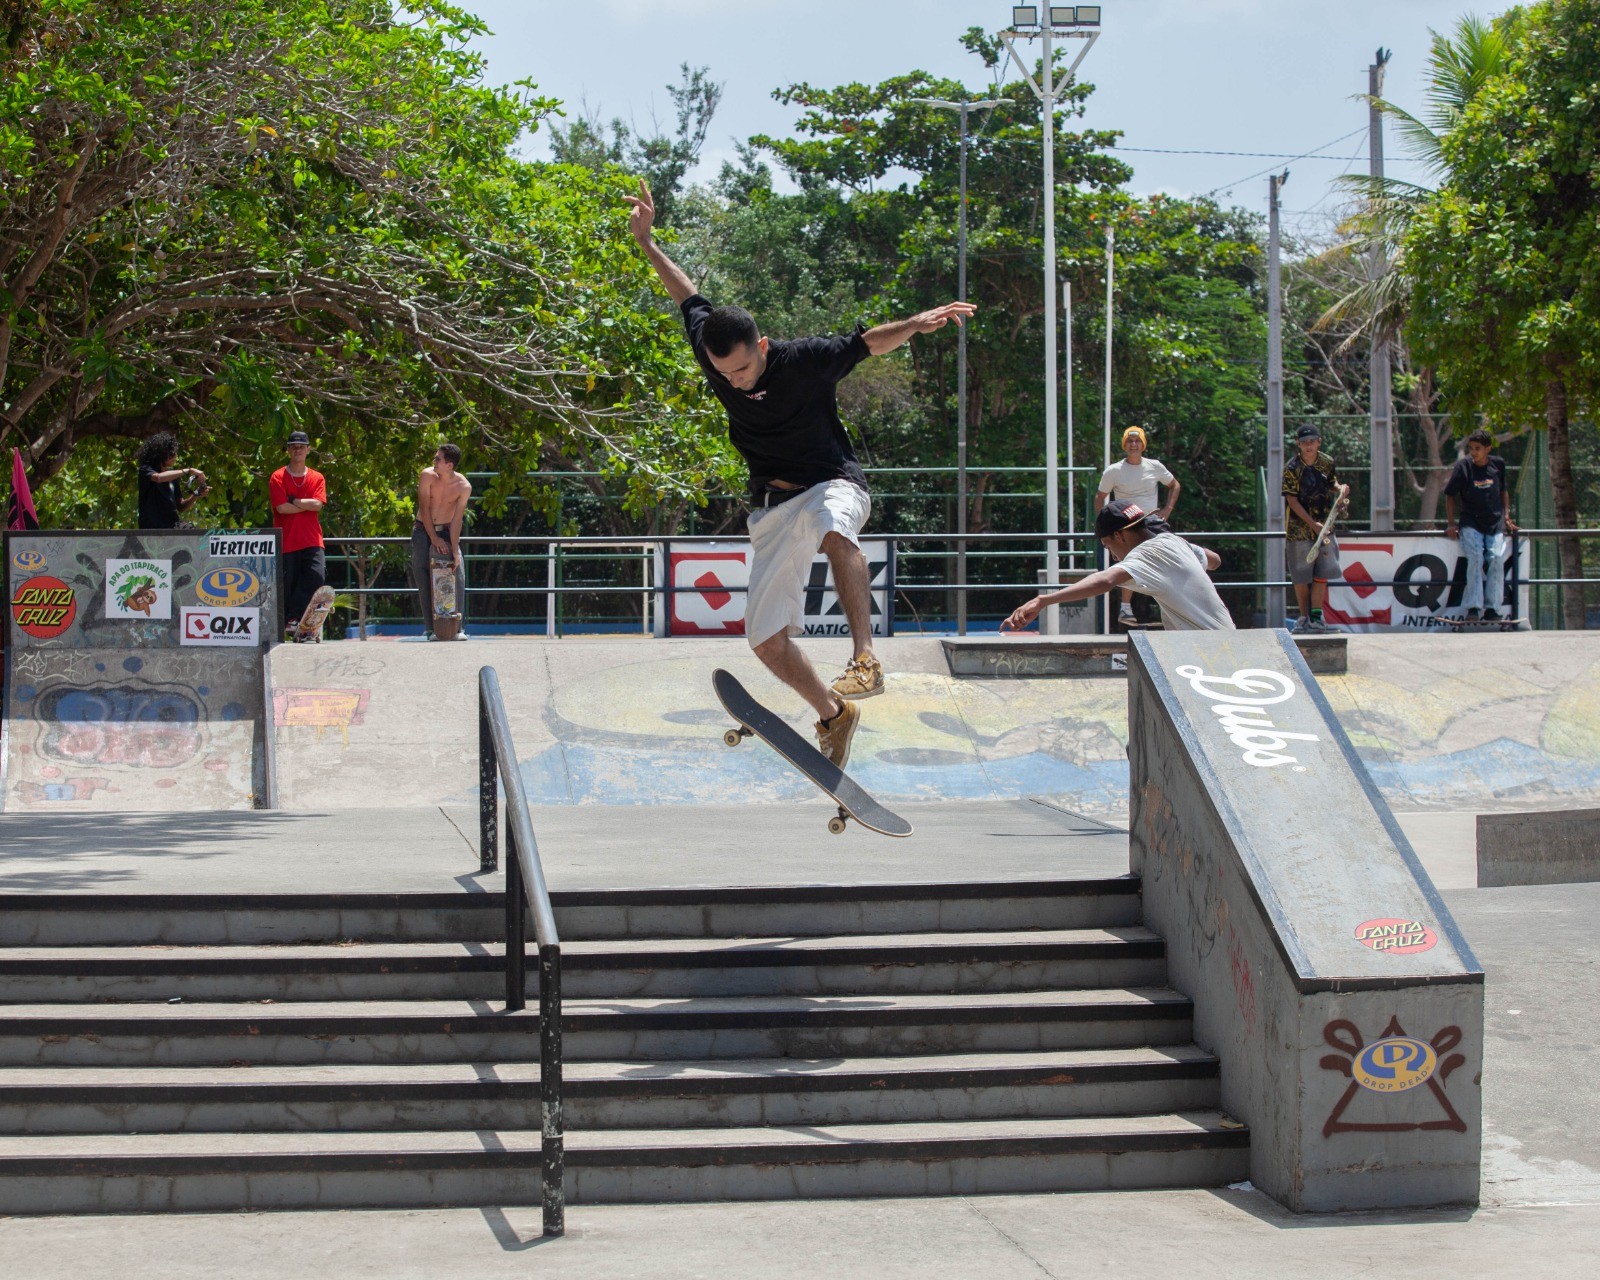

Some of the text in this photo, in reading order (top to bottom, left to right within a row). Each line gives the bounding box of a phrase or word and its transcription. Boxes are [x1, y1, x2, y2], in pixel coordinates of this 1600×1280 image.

[210, 541, 275, 555] VERTICAL
[109, 572, 121, 587] APA
[119, 564, 130, 575] DO
[11, 588, 74, 605] SANTA
[203, 591, 253, 606] DROP DEAD
[17, 608, 68, 626] CRUZ
[209, 616, 254, 634] QIX
[1175, 664, 1320, 767] Dubs
[1354, 921, 1424, 940] SANTA
[1372, 933, 1427, 950] CRUZ
[1362, 1069, 1428, 1090] DROP DEAD
